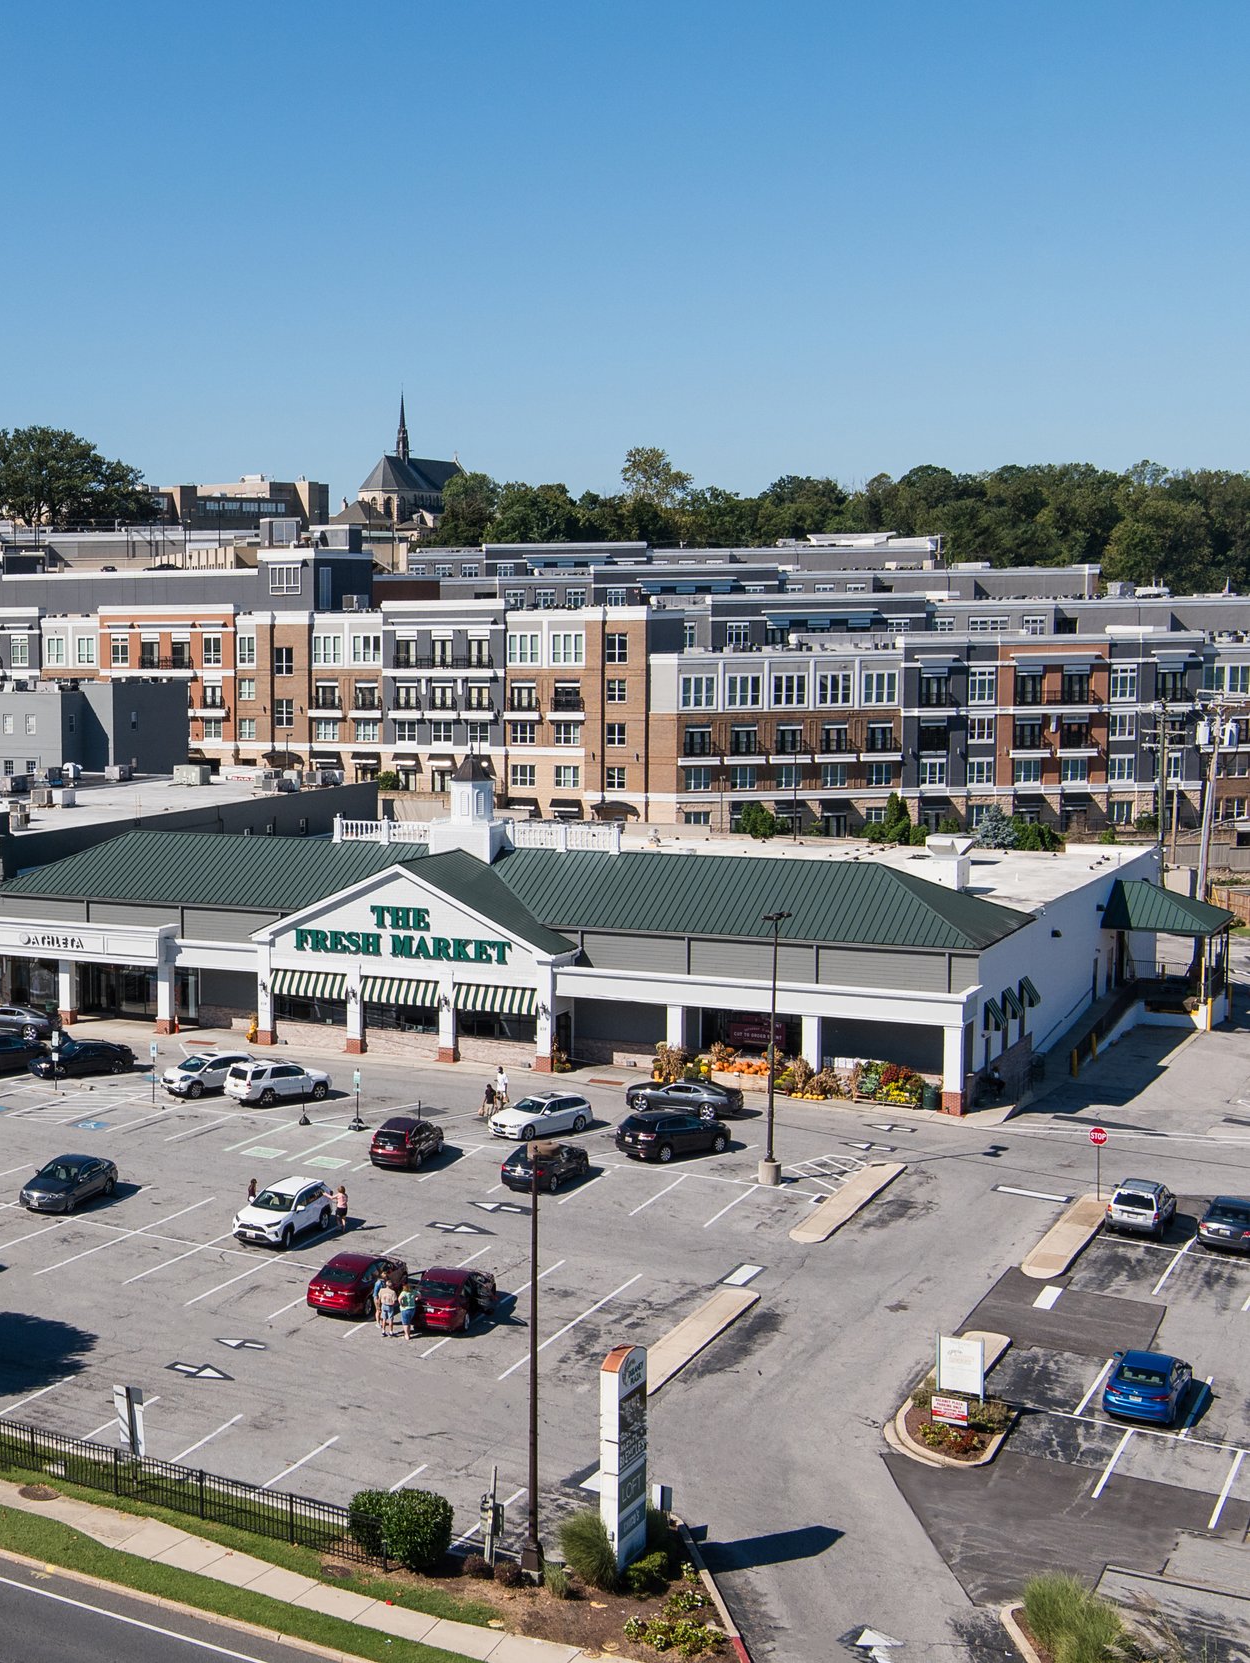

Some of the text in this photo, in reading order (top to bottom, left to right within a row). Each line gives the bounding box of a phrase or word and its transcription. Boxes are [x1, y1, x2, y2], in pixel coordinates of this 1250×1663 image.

[370, 905, 430, 932] THE
[31, 935, 84, 949] ATHLETA
[294, 927, 512, 965] FRESH MARKET
[1090, 1132, 1107, 1141] STOP
[622, 1473, 642, 1503] LOFT
